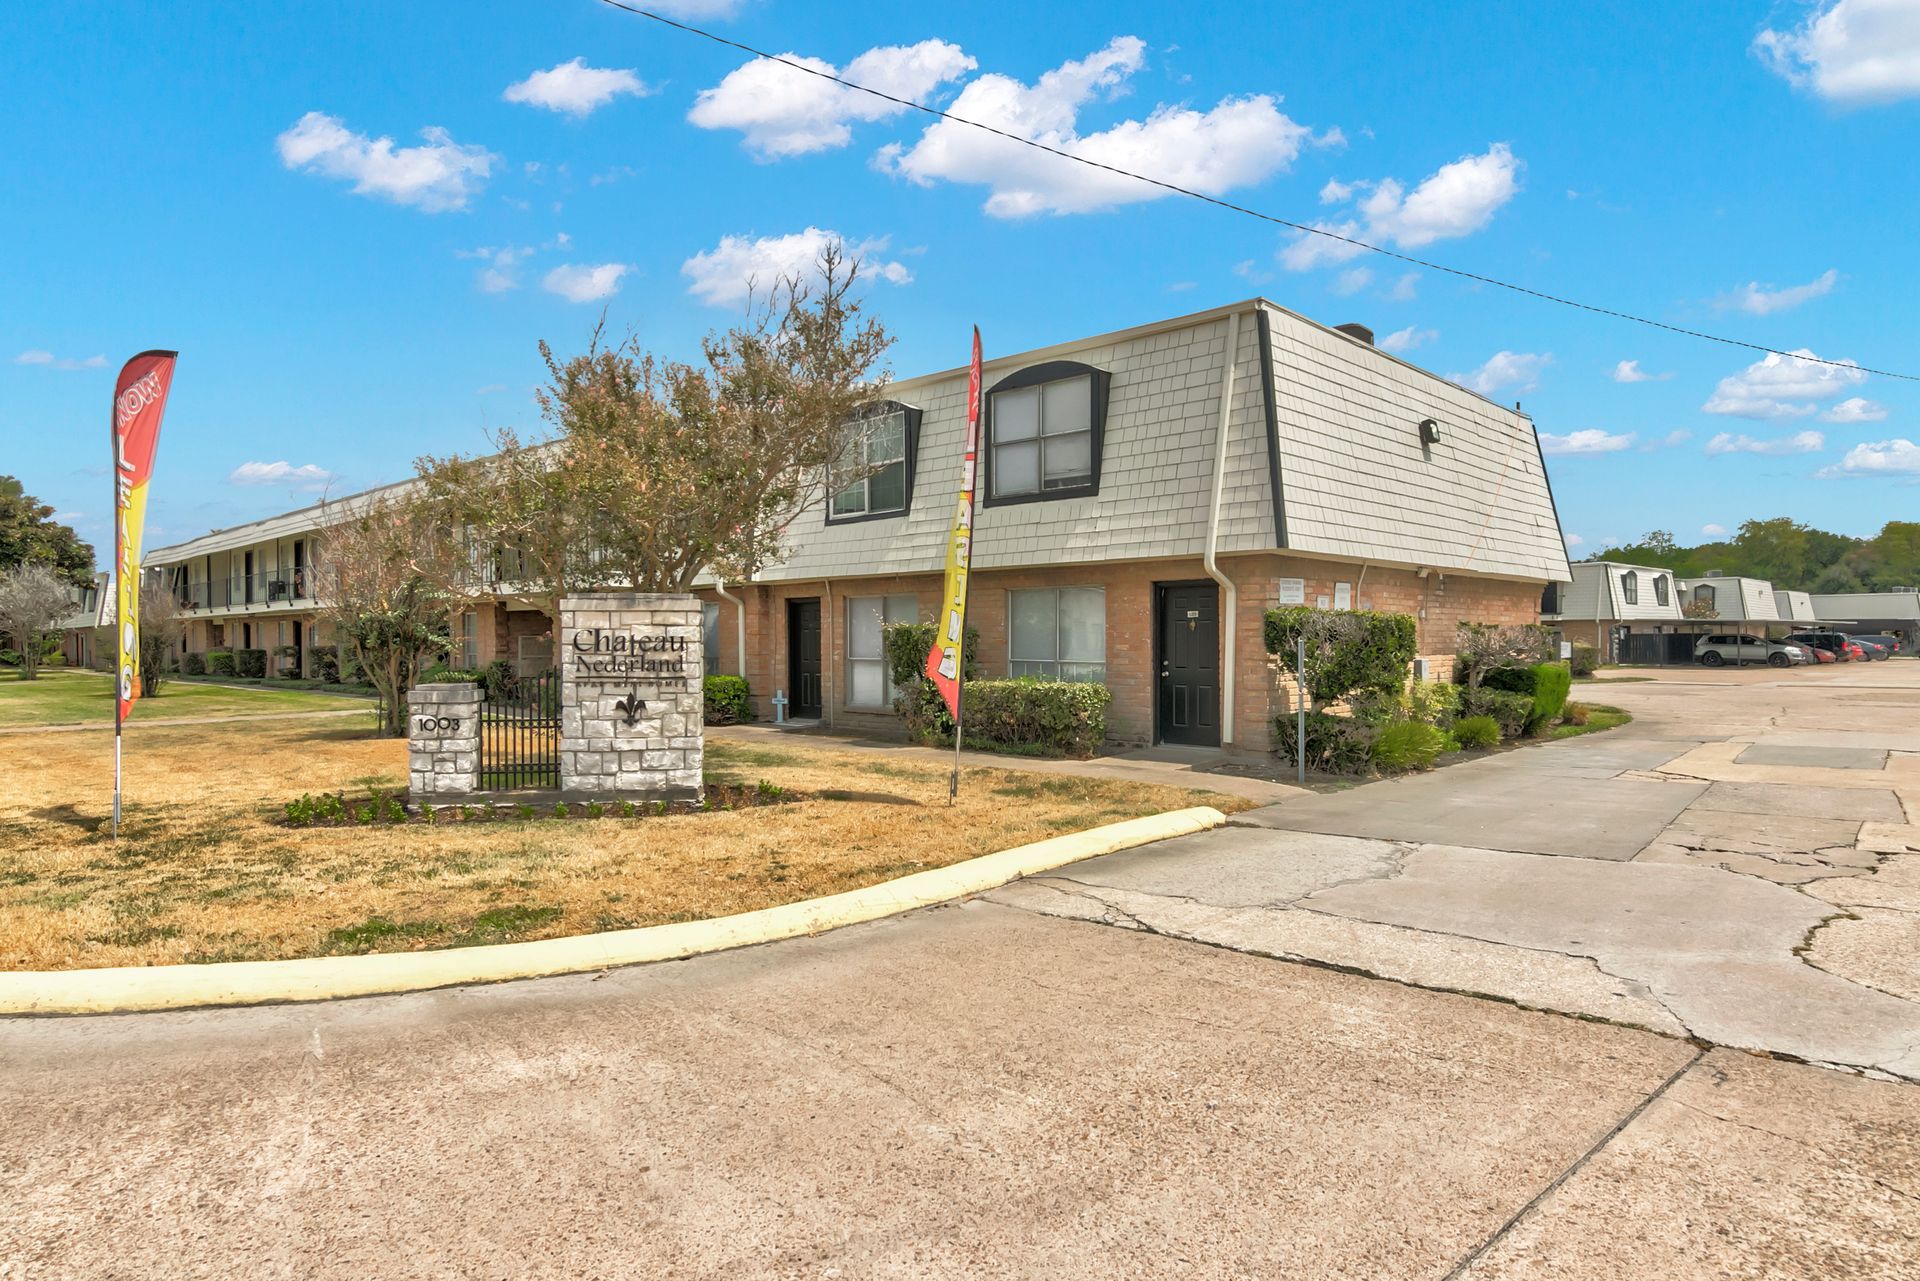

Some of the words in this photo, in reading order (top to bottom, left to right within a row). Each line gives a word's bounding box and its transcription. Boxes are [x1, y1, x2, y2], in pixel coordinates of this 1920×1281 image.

[116, 371, 162, 427] NOW
[573, 628, 686, 657] Chateau
[575, 655, 686, 673] Nederland
[418, 717, 460, 731] 1003
